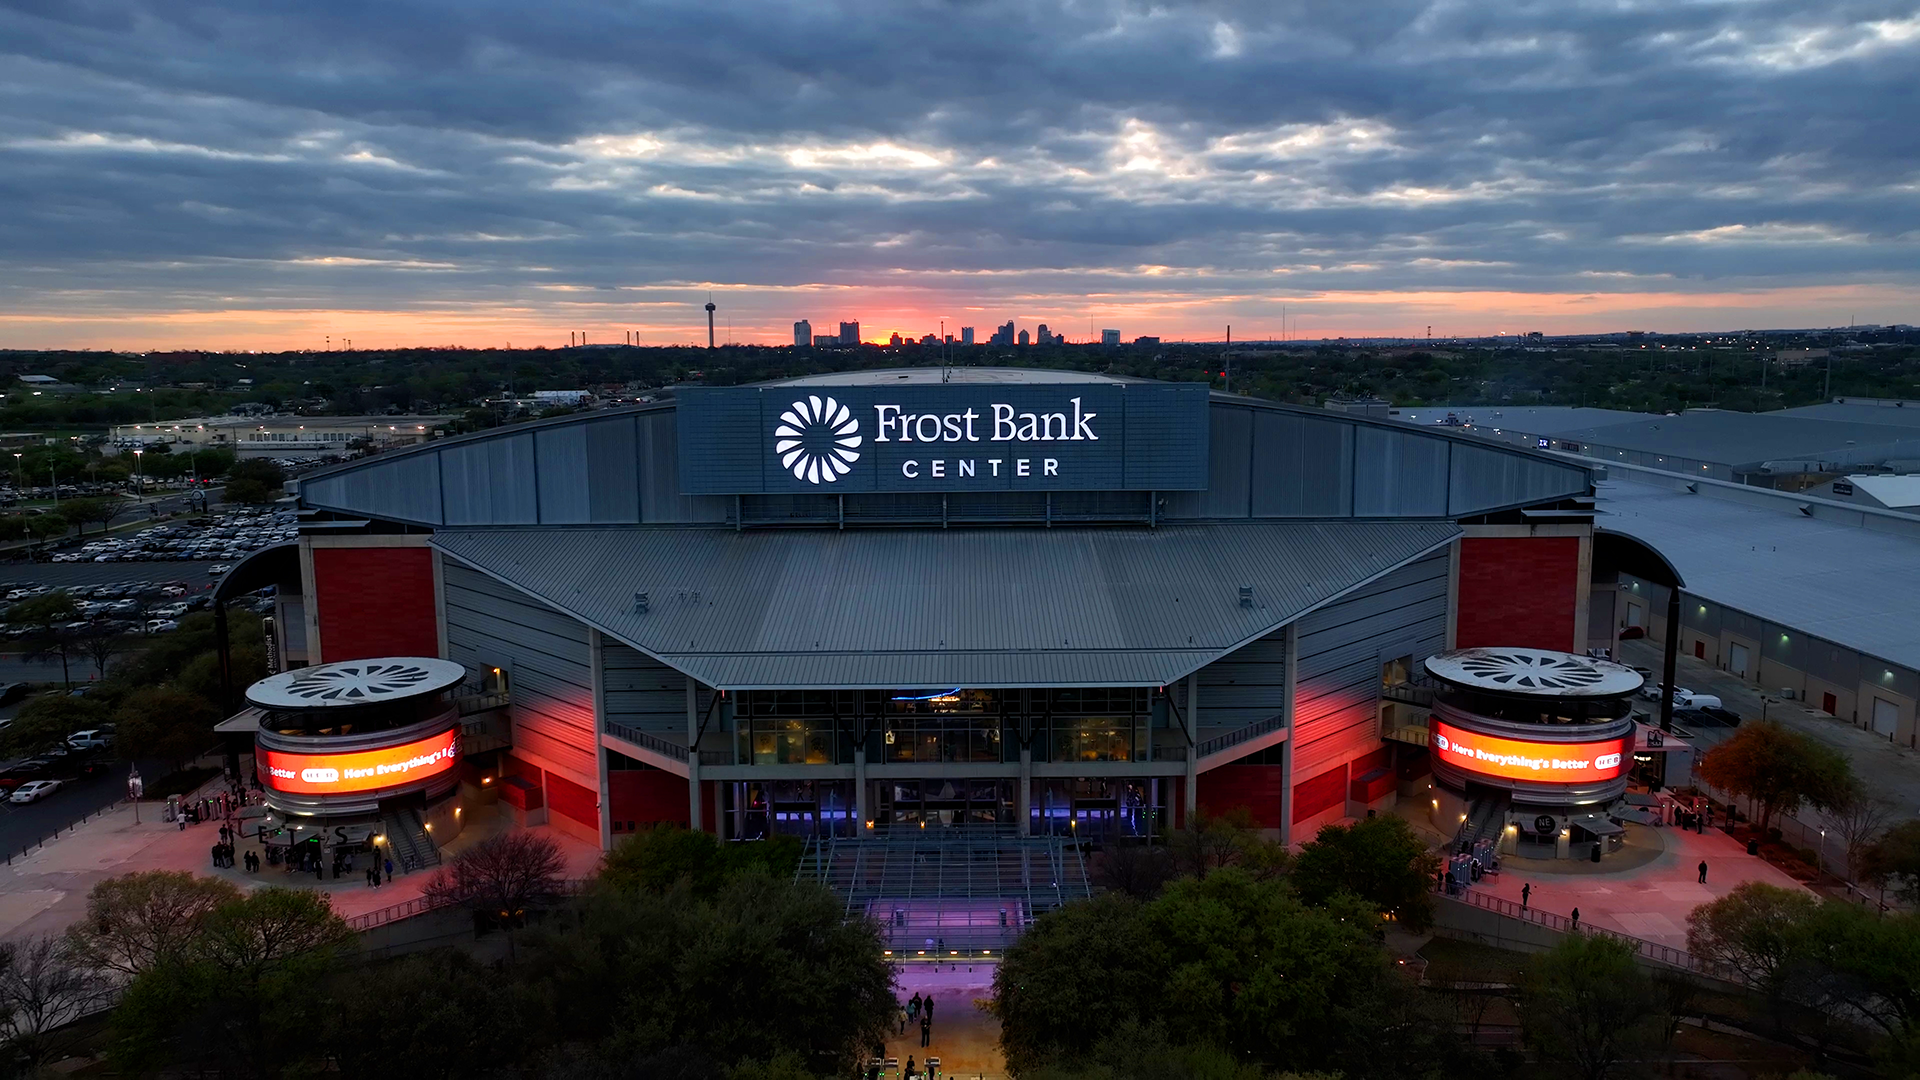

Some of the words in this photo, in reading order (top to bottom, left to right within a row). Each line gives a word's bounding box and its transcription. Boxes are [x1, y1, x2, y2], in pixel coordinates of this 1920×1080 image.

[874, 404, 979, 442] Frost
[990, 397, 1099, 442] Bank
[902, 458, 1060, 479] CENTER
[263, 634, 273, 669] Methodist
[269, 766, 296, 779] Better
[344, 766, 375, 779] Here
[376, 750, 441, 775] Everything's
[1452, 742, 1474, 758] Here
[1476, 749, 1550, 770] Everything's
[1552, 758, 1589, 769] Better
